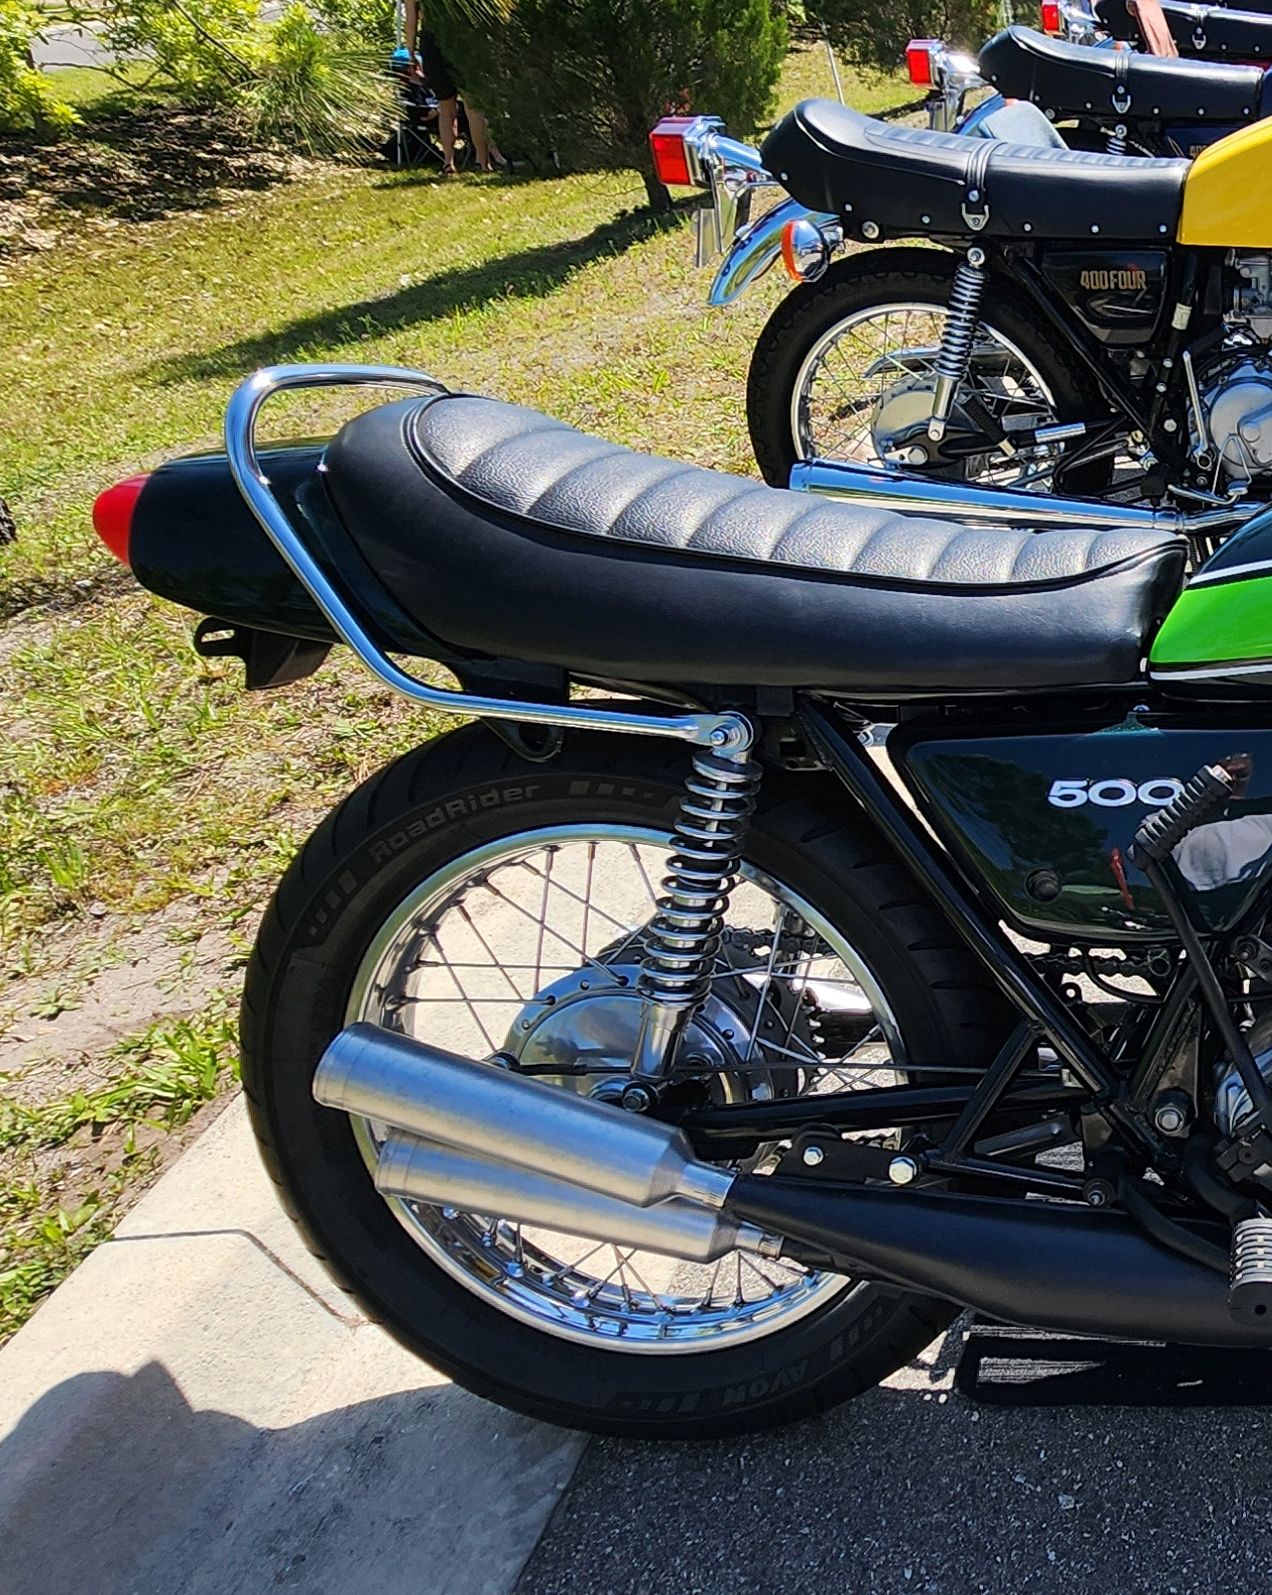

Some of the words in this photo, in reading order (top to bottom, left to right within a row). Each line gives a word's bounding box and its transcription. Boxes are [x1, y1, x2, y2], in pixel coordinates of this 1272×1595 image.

[1047, 779, 1187, 808] 500
[368, 784, 541, 864] RoadRider
[721, 1358, 808, 1407] AVON
